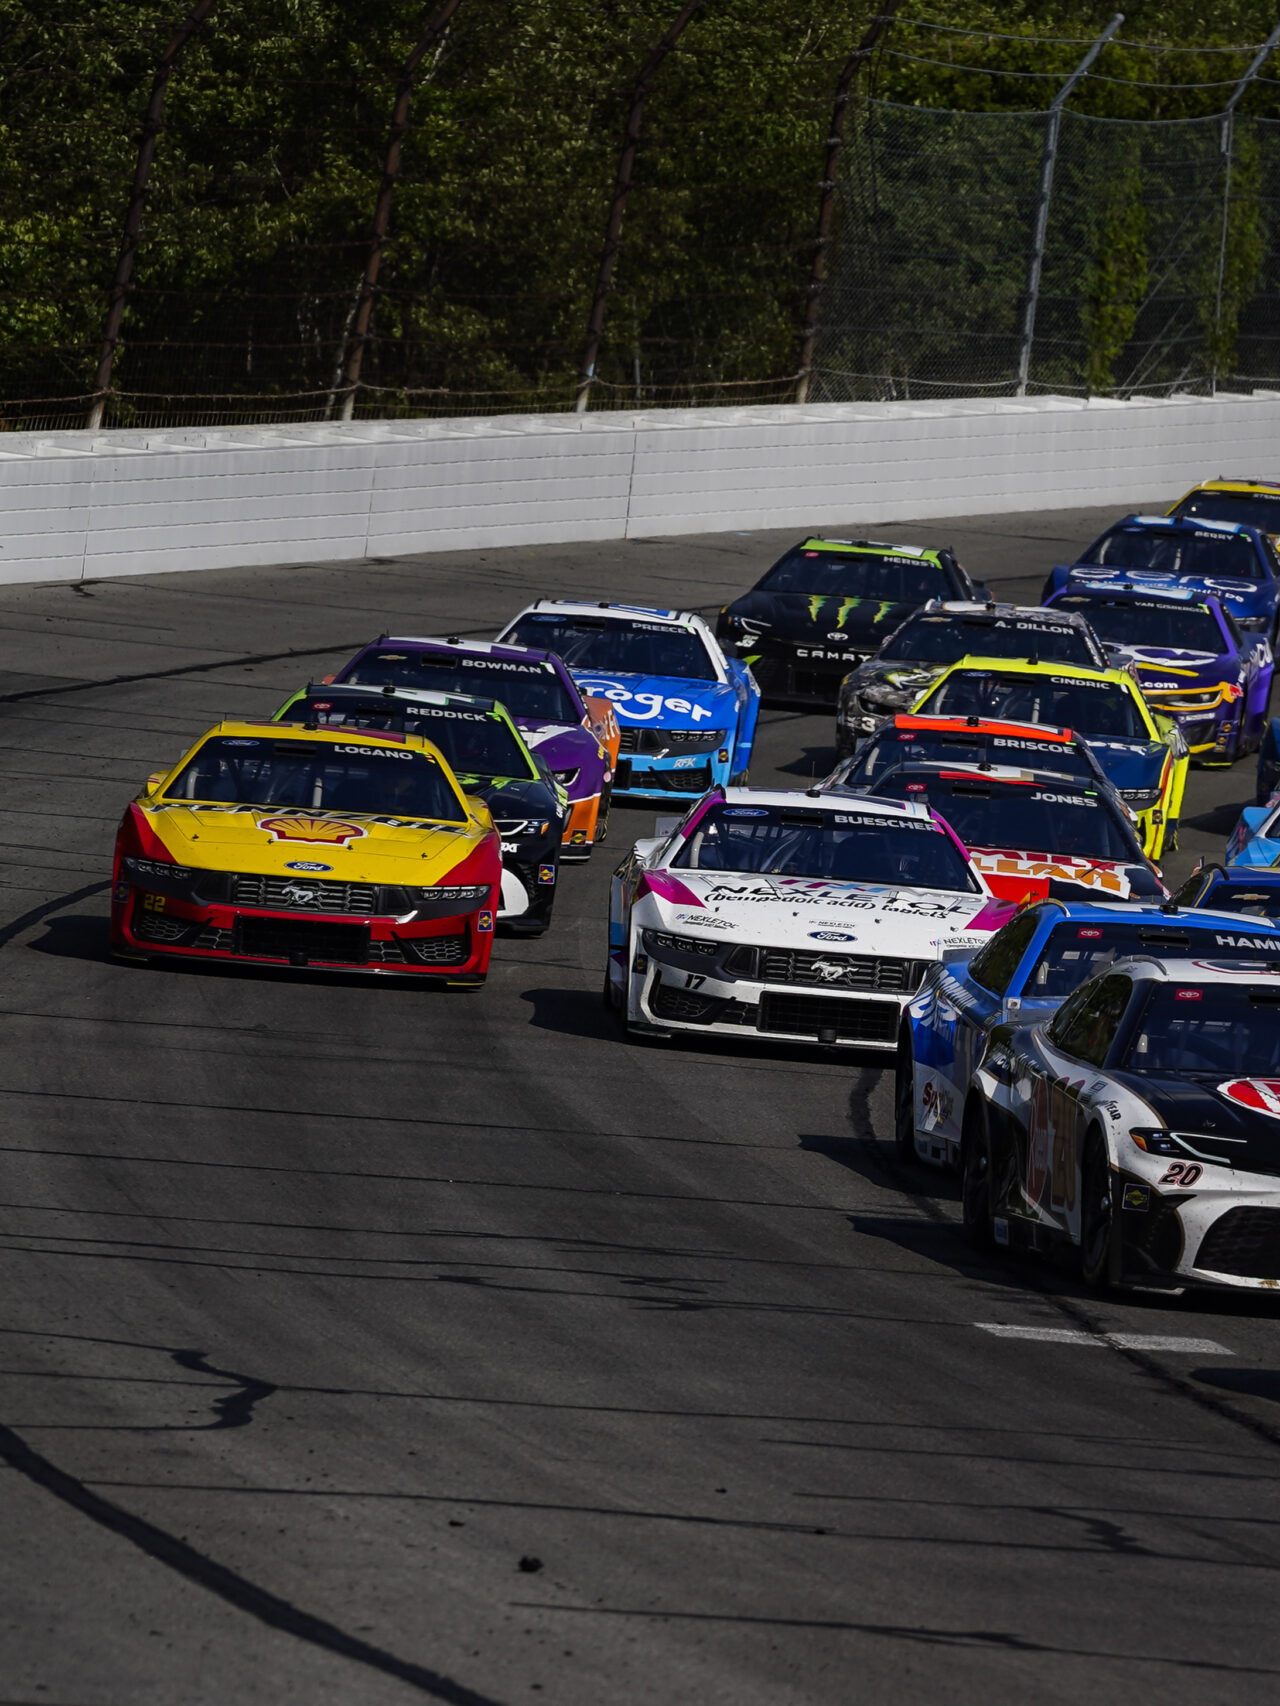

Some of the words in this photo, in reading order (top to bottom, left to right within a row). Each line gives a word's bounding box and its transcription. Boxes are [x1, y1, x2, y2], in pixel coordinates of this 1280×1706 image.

[1194, 531, 1235, 541] BERRY
[632, 622, 687, 635] PREECE
[994, 620, 1011, 629] A.
[1016, 622, 1075, 636] DILLON
[796, 649, 874, 663] CAMRY
[461, 659, 543, 675] BOWMAN
[1050, 676, 1111, 690] CINDRIC
[573, 679, 713, 722] roger
[406, 706, 487, 722] REDDICK
[861, 717, 876, 733] 3
[333, 744, 414, 760] LOGANO
[993, 738, 1076, 755] BRISCOE
[1030, 792, 1099, 808] JONES
[834, 814, 940, 832] BUESCHER
[143, 893, 167, 912] 22
[710, 885, 972, 915] NEXLETOL
[686, 914, 740, 929] NEXLETOL
[684, 973, 708, 990] 17
[1158, 1161, 1204, 1188] 20
